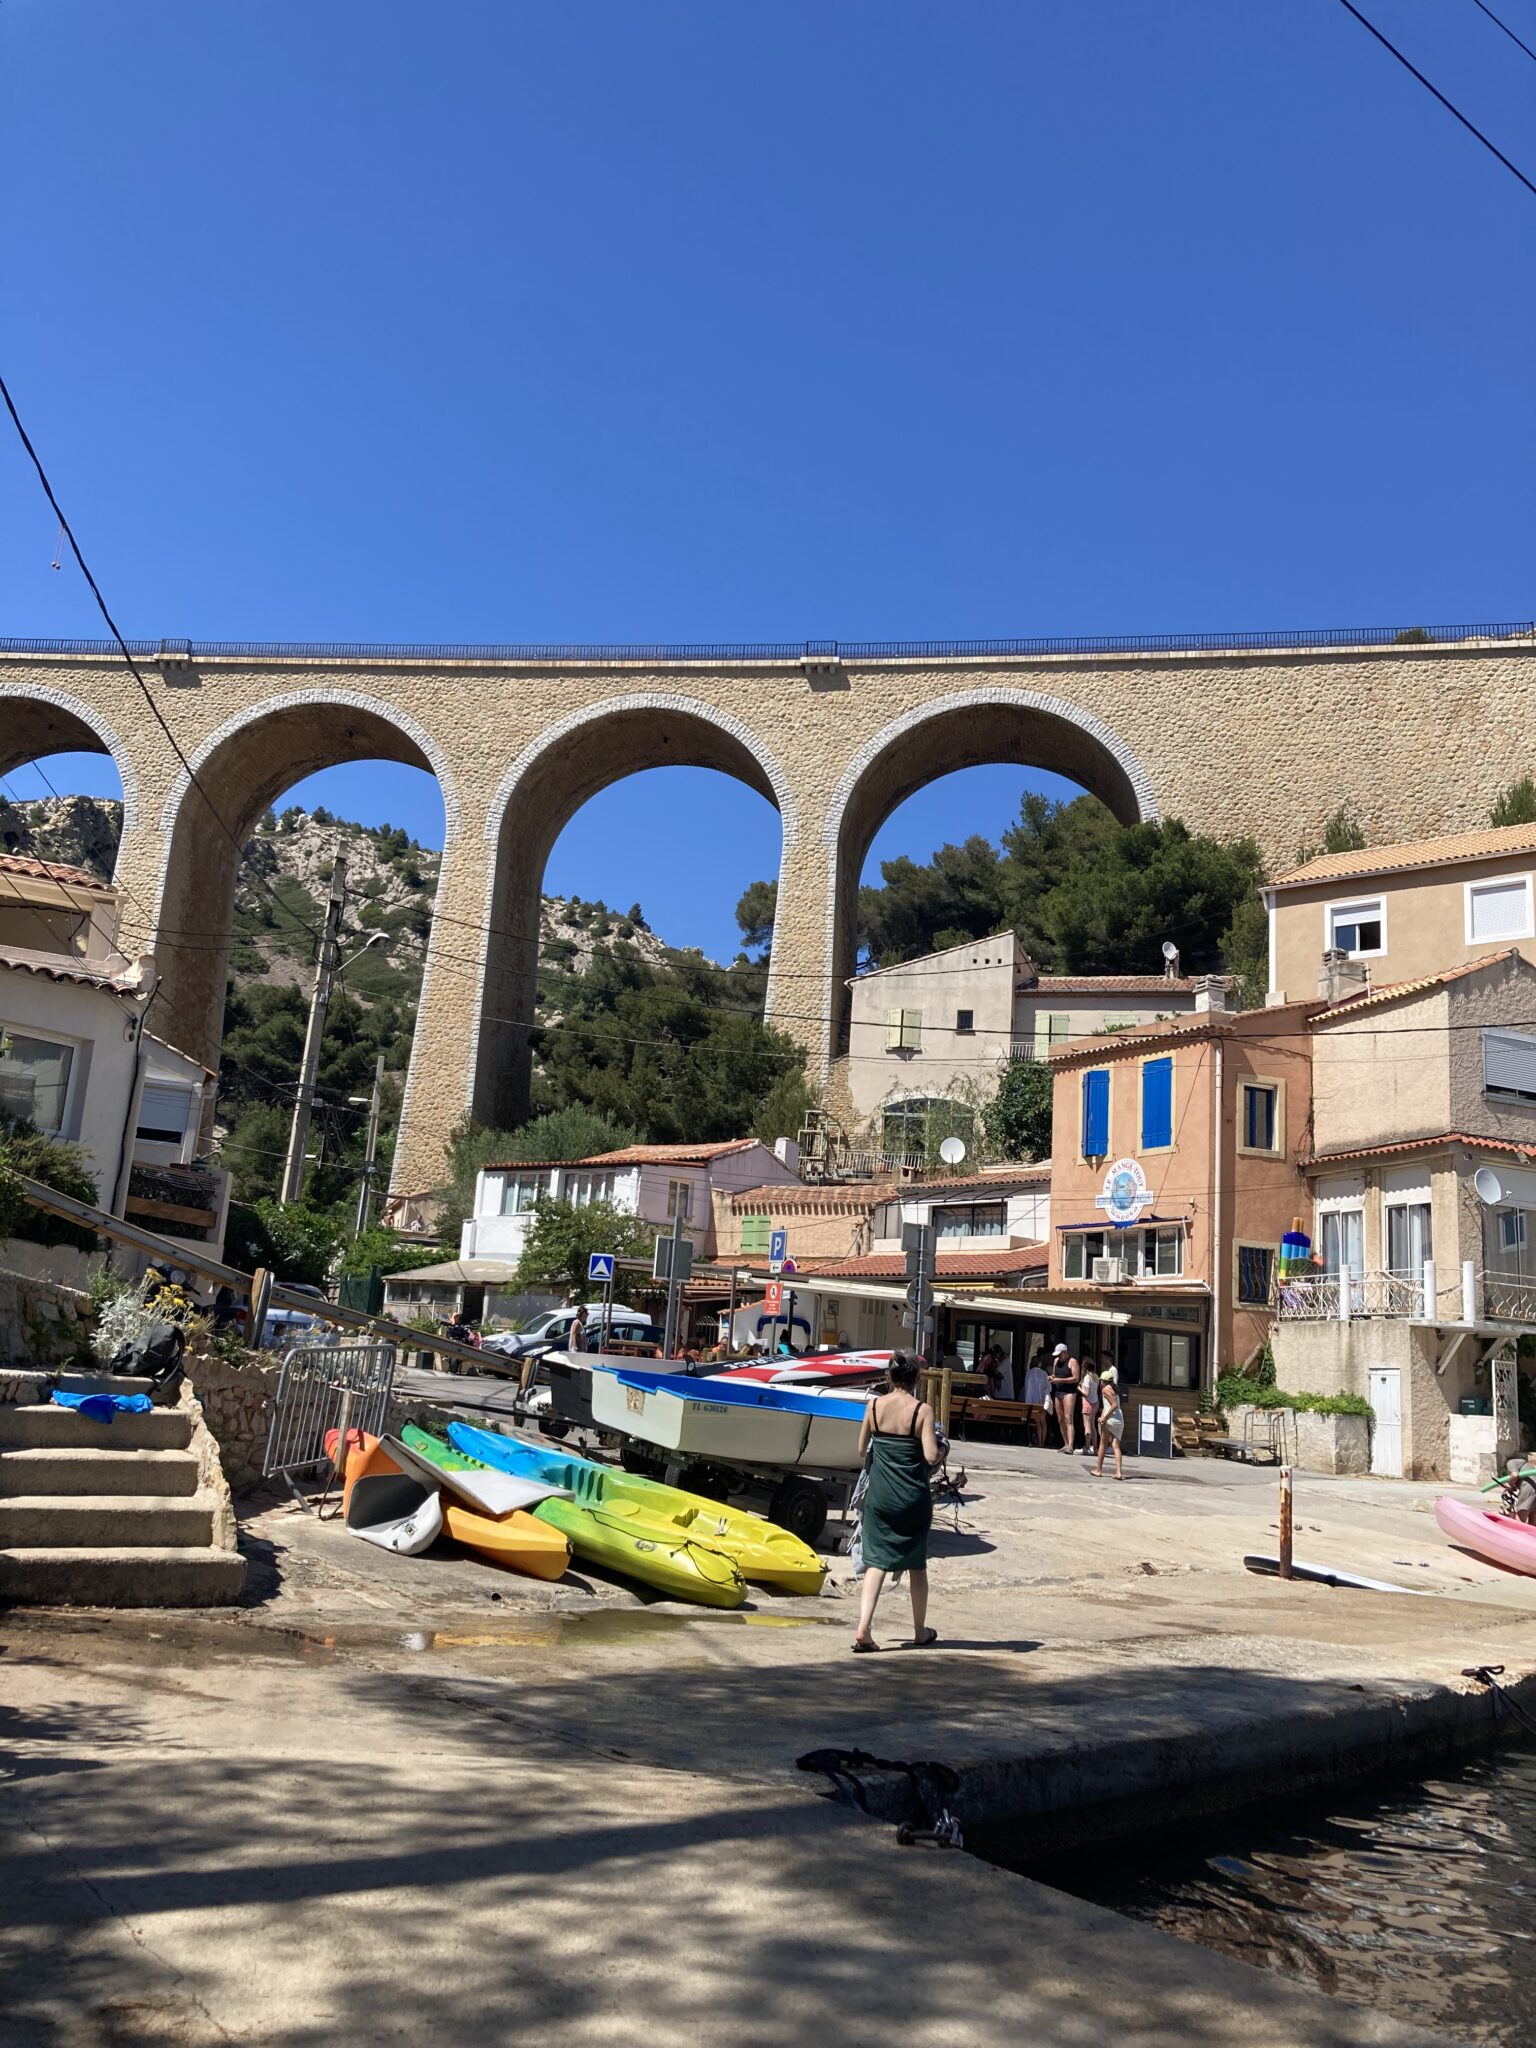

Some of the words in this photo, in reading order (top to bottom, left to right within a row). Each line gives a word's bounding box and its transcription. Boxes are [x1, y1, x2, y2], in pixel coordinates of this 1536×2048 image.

[1105, 1179, 1112, 1190] LE
[773, 1237, 782, 1256] P
[693, 1402, 701, 1411] TL
